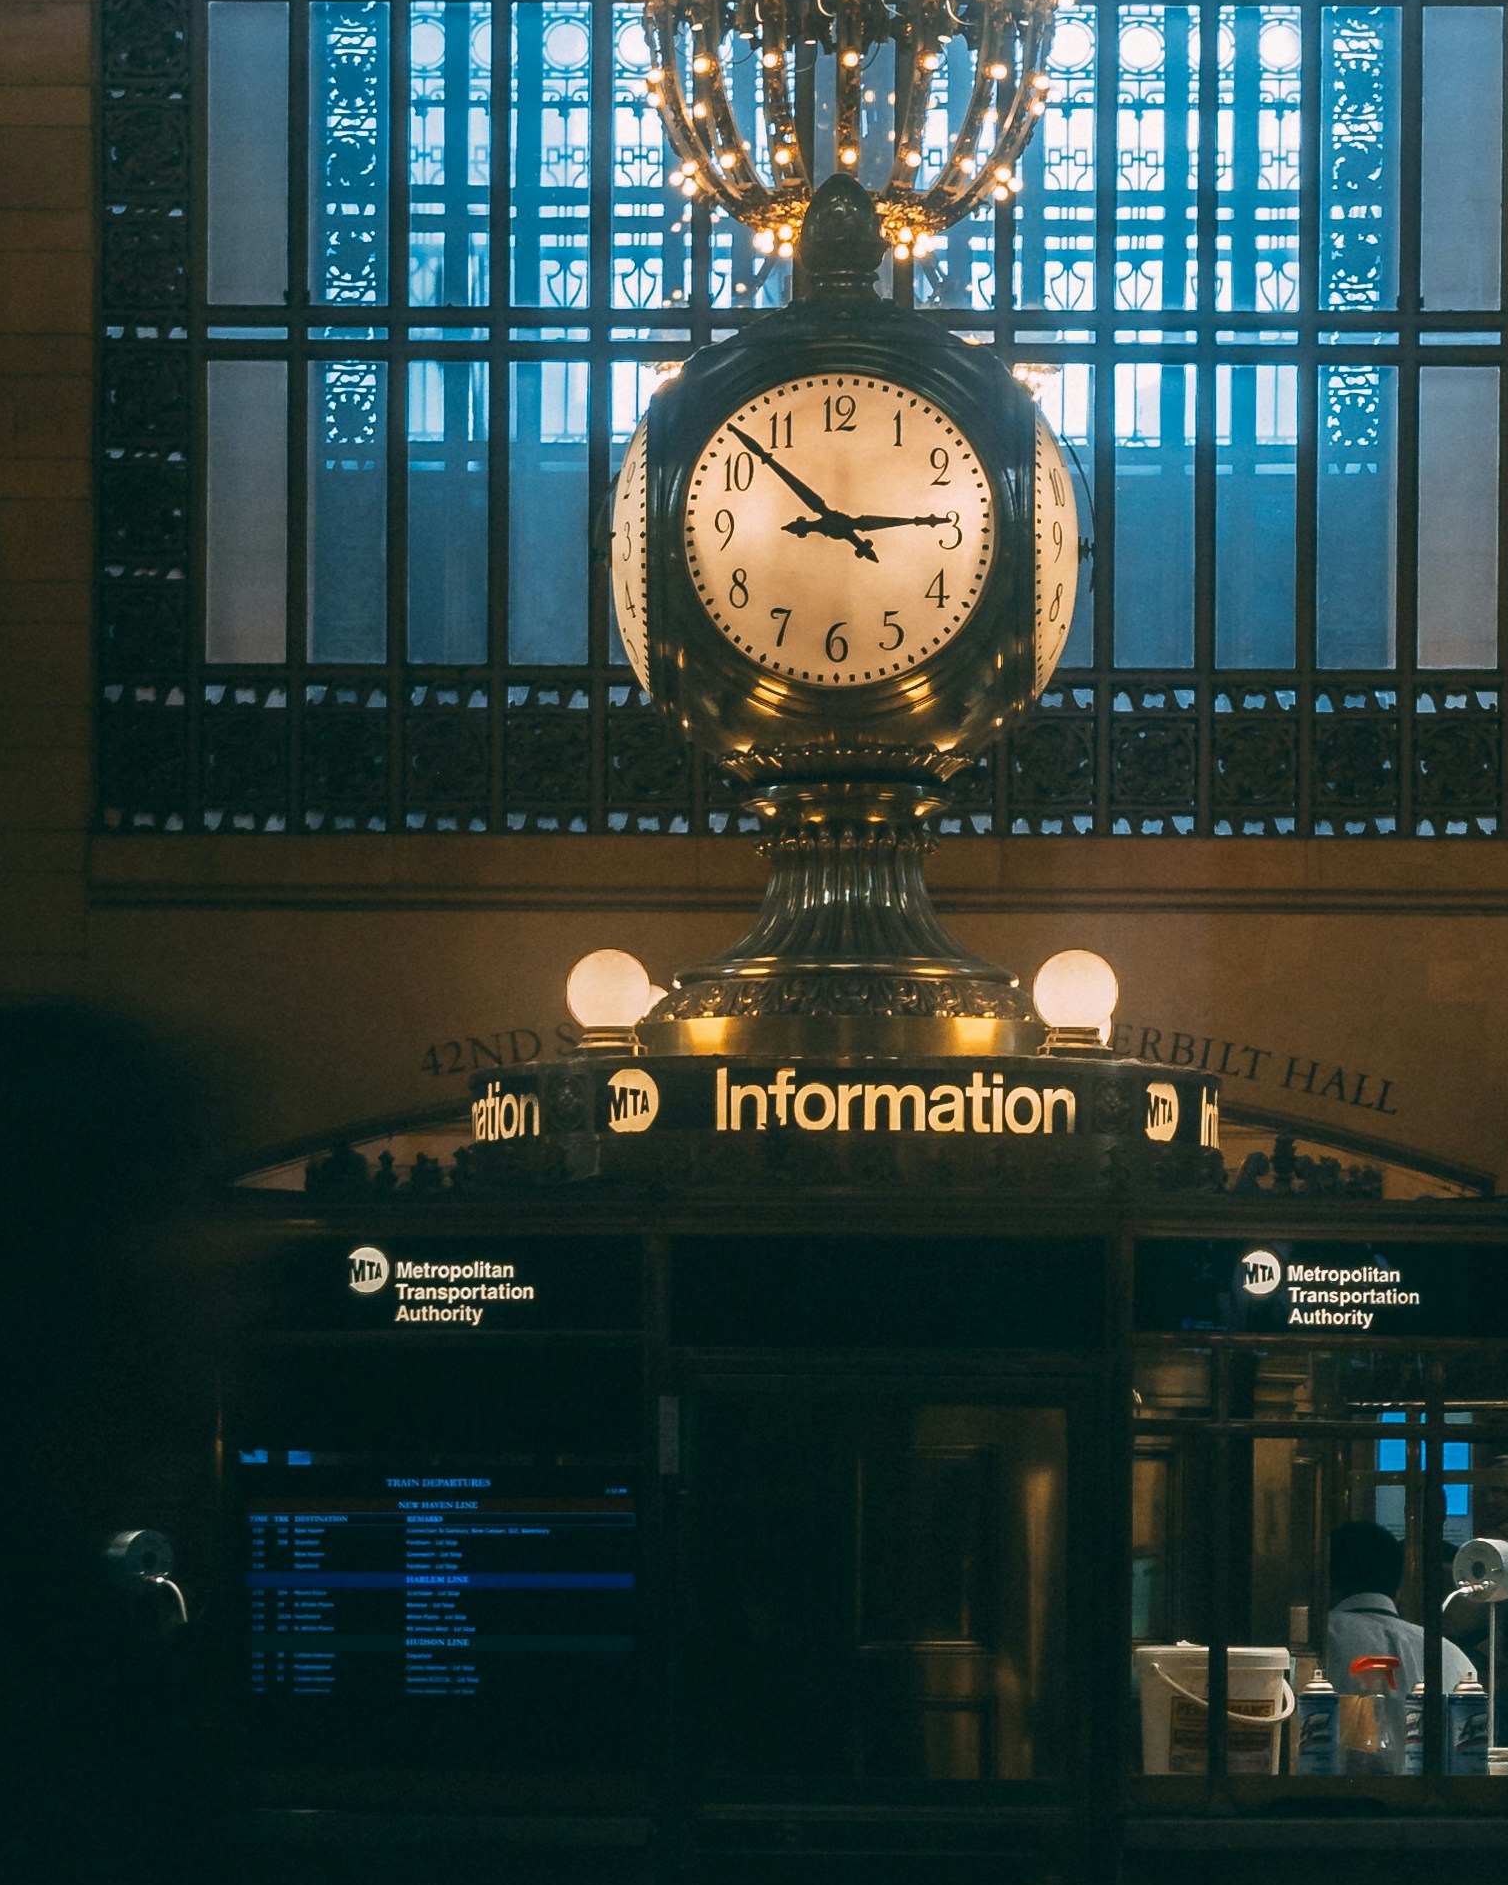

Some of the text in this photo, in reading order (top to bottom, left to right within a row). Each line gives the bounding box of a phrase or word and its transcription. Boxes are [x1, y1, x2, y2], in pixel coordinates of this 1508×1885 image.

[768, 411, 794, 449] 11
[824, 394, 857, 432] 12
[892, 410, 903, 447] 1
[724, 452, 754, 491] 10
[930, 447, 951, 486] 2
[714, 509, 735, 551] 9
[938, 510, 963, 550] 3
[1053, 521, 1063, 564] 9
[729, 568, 749, 609] 8
[924, 568, 951, 609] 4
[1049, 583, 1063, 622] 8
[770, 608, 792, 647] 7
[825, 622, 849, 663] 6
[878, 610, 904, 650] 5
[421, 1029, 542, 1076] 42ND
[715, 1067, 1076, 1134] Information
[1281, 1056, 1398, 1115] HALL
[395, 1261, 514, 1282] Metropolitan
[1287, 1265, 1401, 1286] Metropolitan
[395, 1283, 535, 1304] Transportation
[1288, 1287, 1420, 1307] Transportation
[395, 1305, 484, 1326] Authority
[1288, 1308, 1374, 1330] Authority
[386, 1478, 491, 1488] TRAIN DEPARTURES
[455, 1501, 478, 1510] LINE
[446, 1575, 470, 1584] LINE
[406, 1638, 471, 1647] HUDSON LINE
